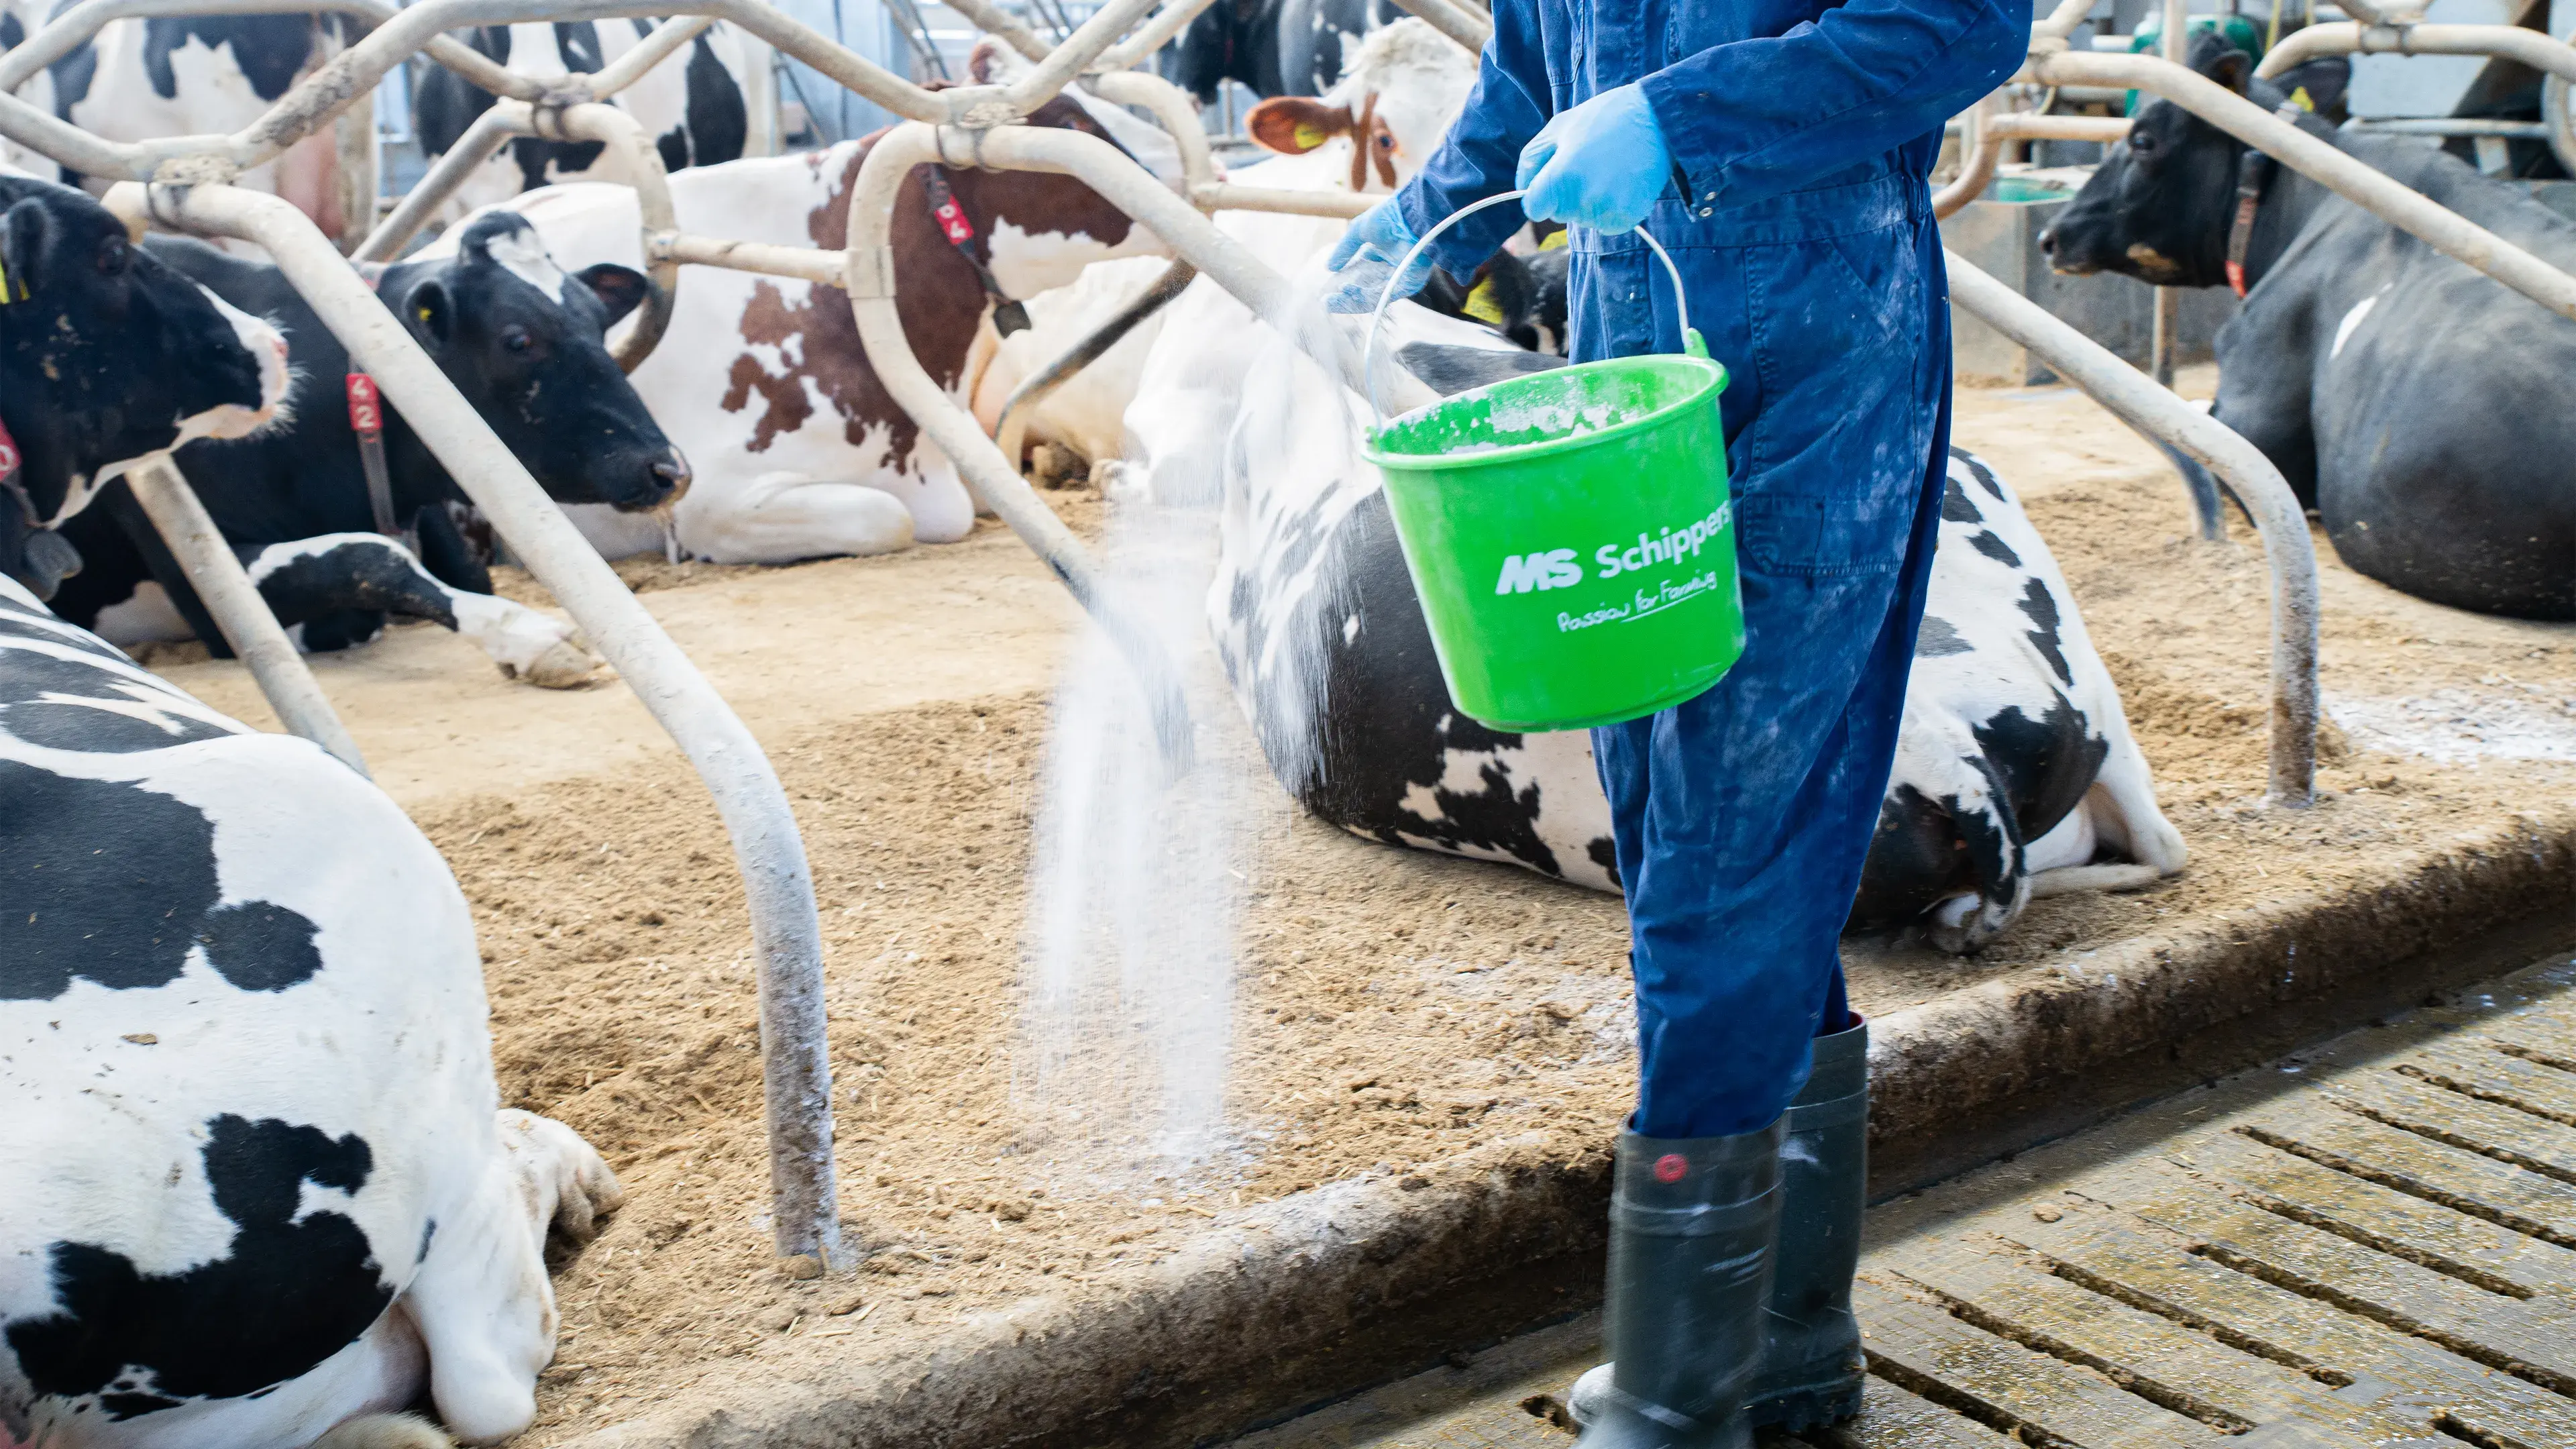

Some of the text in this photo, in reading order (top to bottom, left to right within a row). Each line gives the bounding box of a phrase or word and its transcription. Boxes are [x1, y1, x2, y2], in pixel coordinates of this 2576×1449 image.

[1495, 548, 1583, 595] MS
[1557, 568, 1717, 633] Passion for Farming
